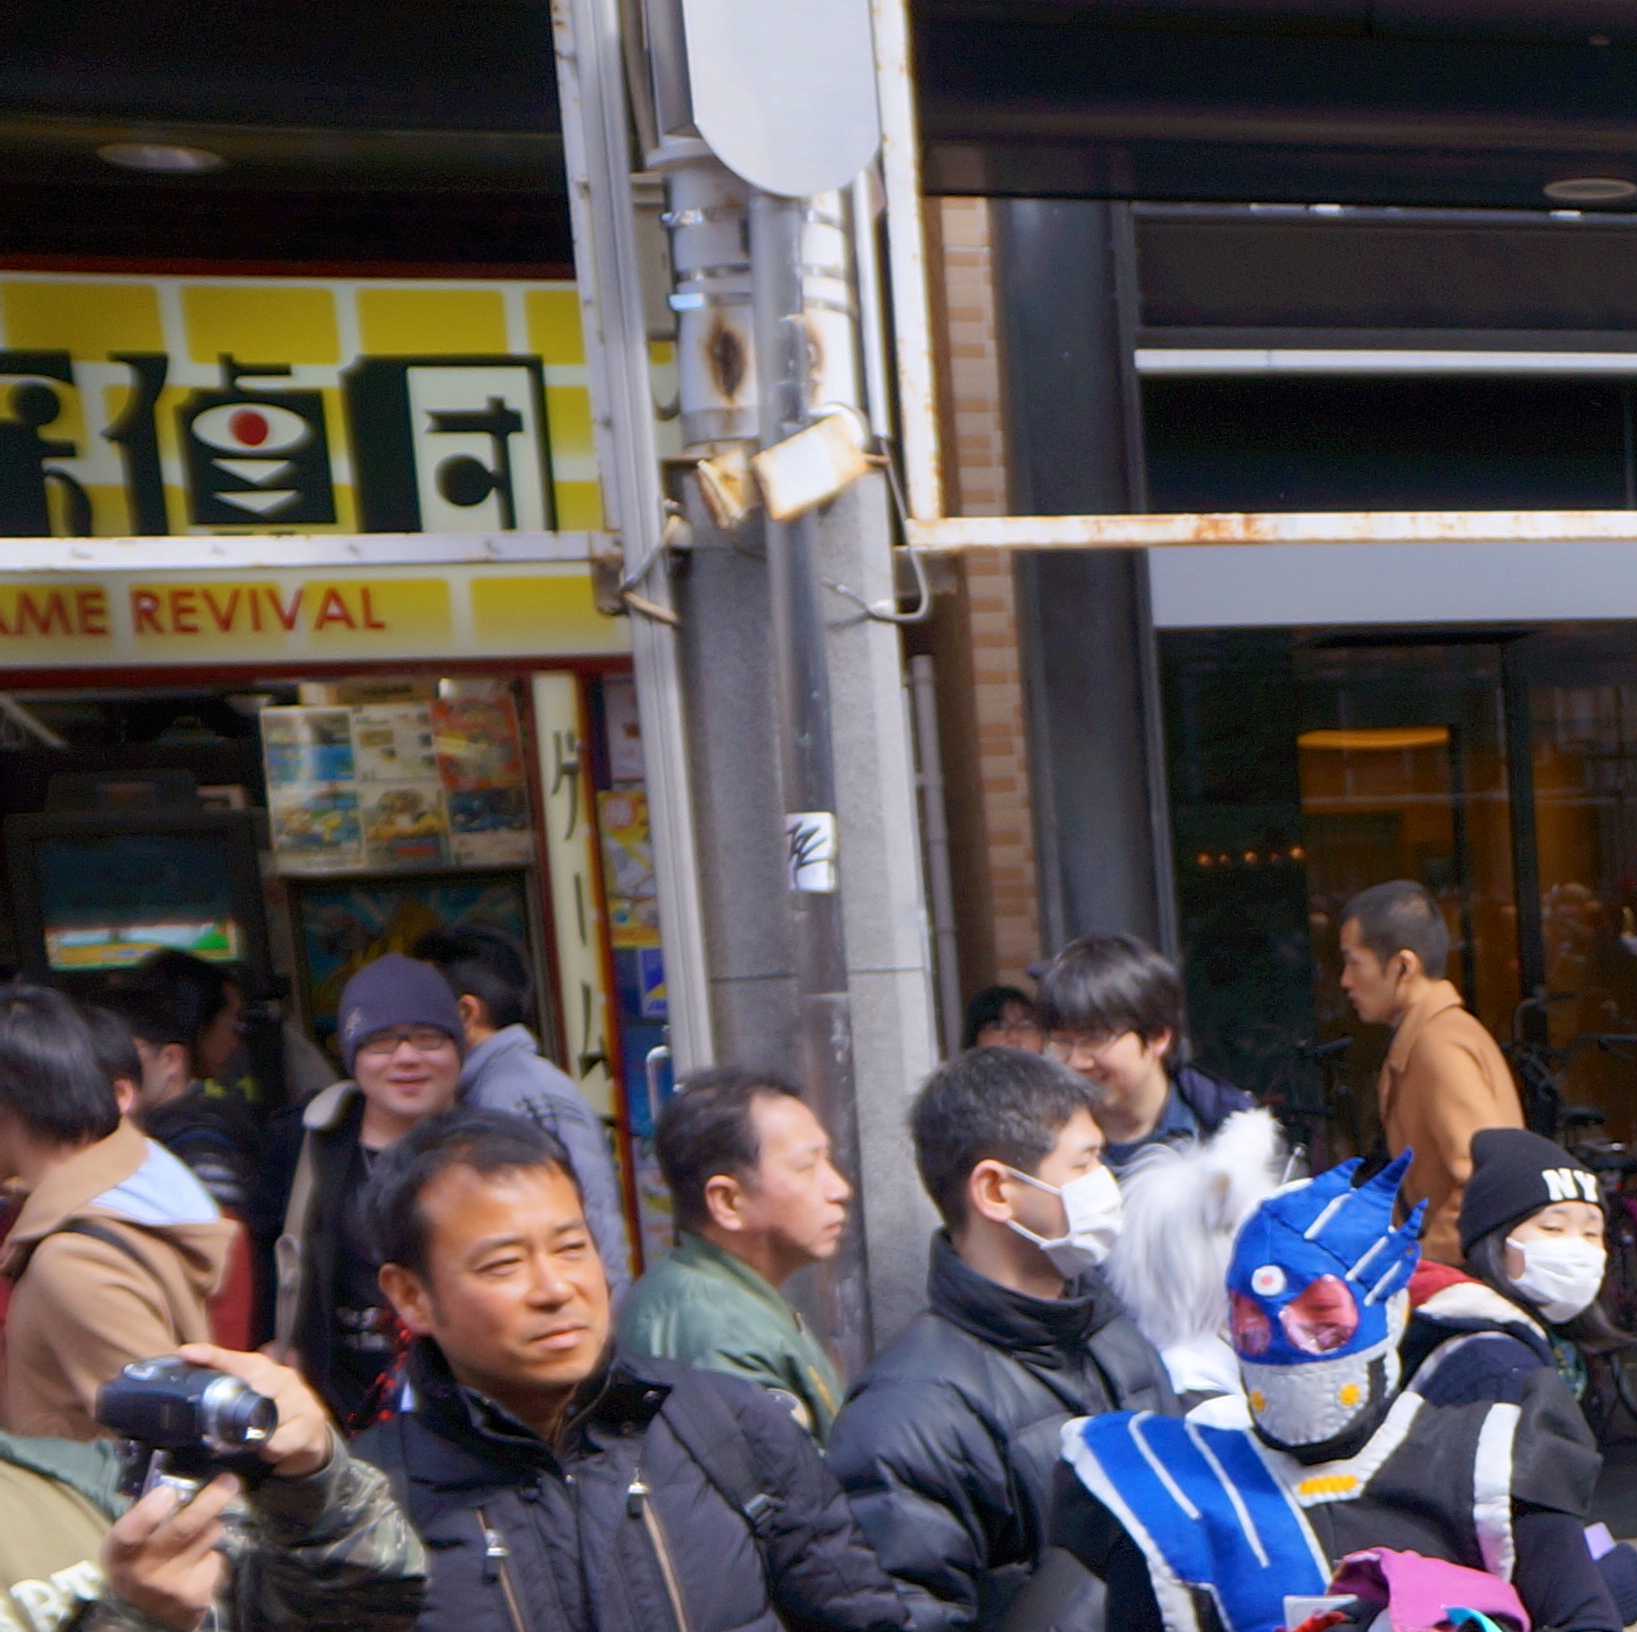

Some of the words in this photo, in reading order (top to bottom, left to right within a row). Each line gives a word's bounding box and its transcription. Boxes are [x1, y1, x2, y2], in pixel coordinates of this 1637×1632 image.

[0, 588, 109, 636] ME
[130, 587, 387, 634] REVIVAL
[1541, 1167, 1599, 1203] NY
